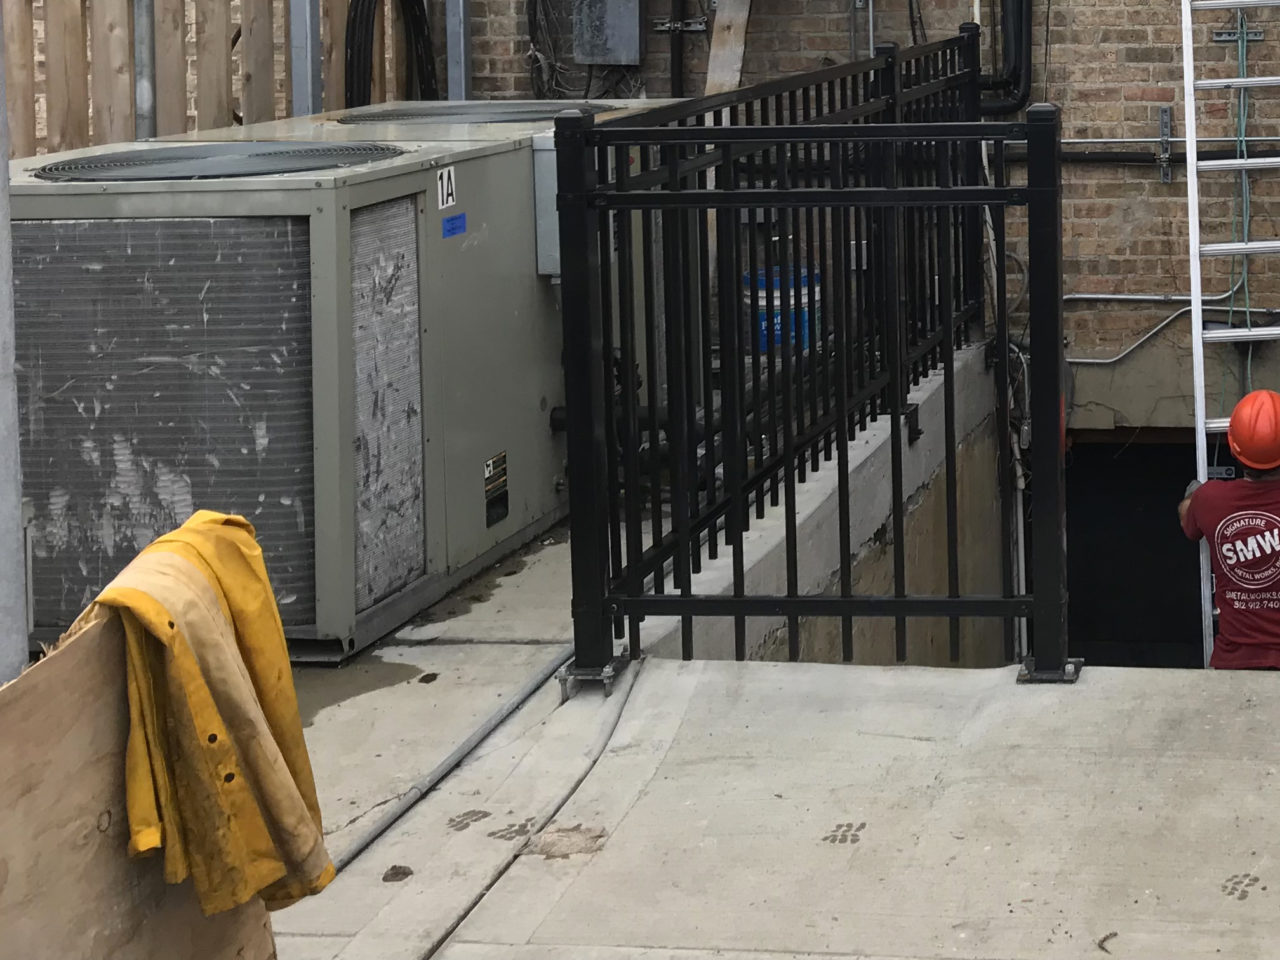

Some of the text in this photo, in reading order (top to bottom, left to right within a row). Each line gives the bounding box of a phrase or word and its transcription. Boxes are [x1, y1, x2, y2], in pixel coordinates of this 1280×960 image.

[438, 169, 455, 206] 1A
[1224, 518, 1266, 537] SIGNATURE
[1222, 528, 1280, 564] SMW
[1234, 567, 1253, 579] METAL
